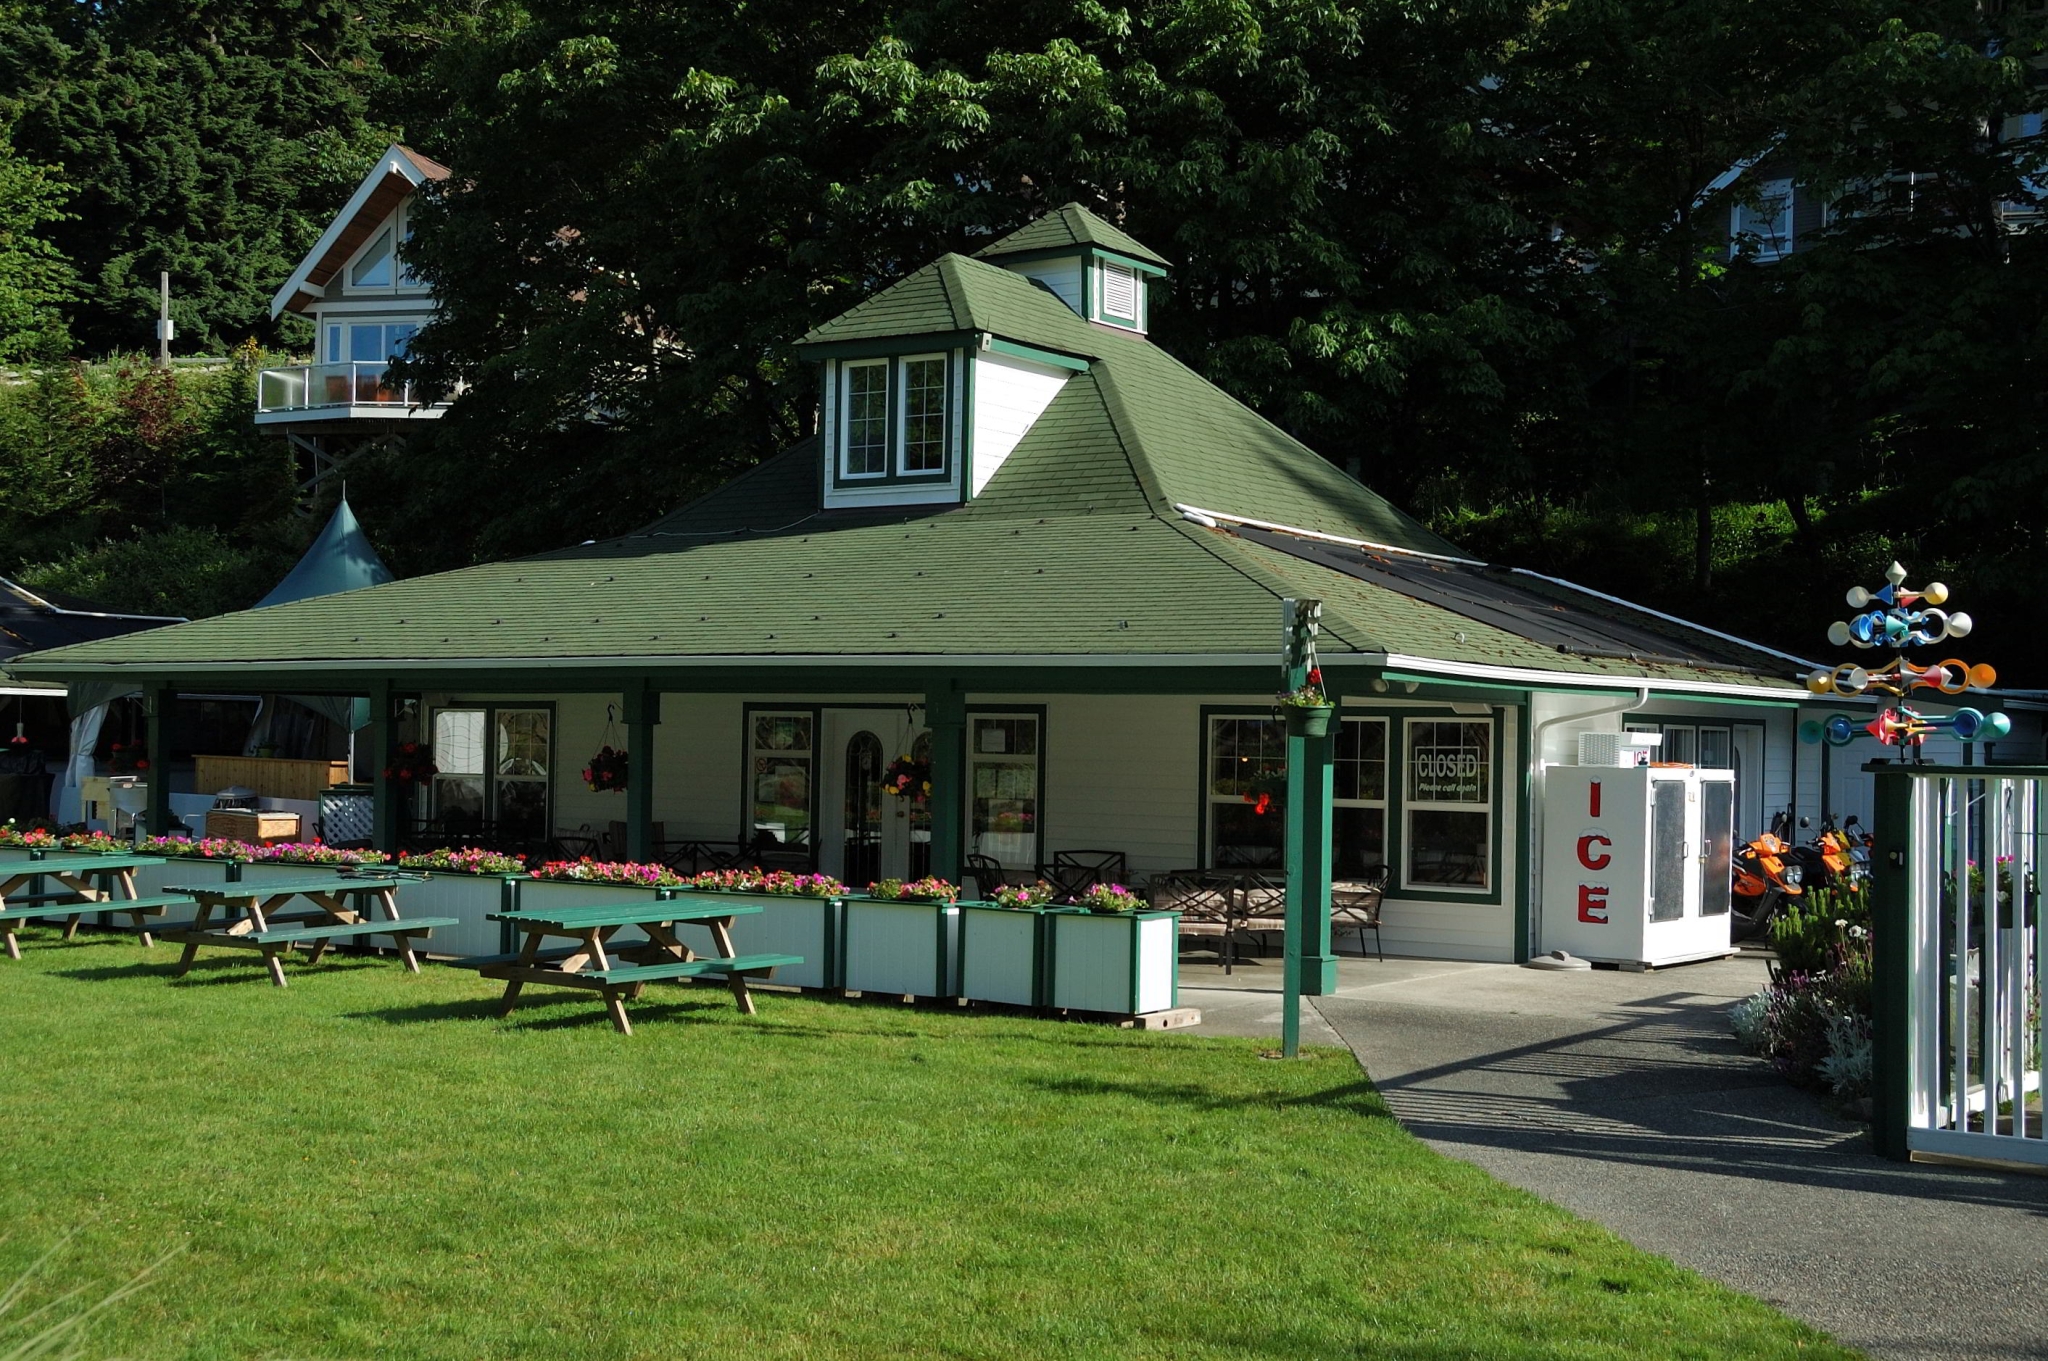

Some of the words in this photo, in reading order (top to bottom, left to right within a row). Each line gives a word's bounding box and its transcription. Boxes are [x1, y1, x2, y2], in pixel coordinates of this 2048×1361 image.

[1418, 754, 1477, 777] CLOSED
[1419, 783, 1441, 791] Please
[1442, 783, 1456, 792] call
[1456, 783, 1476, 793] again
[1577, 775, 1612, 924] ICE
